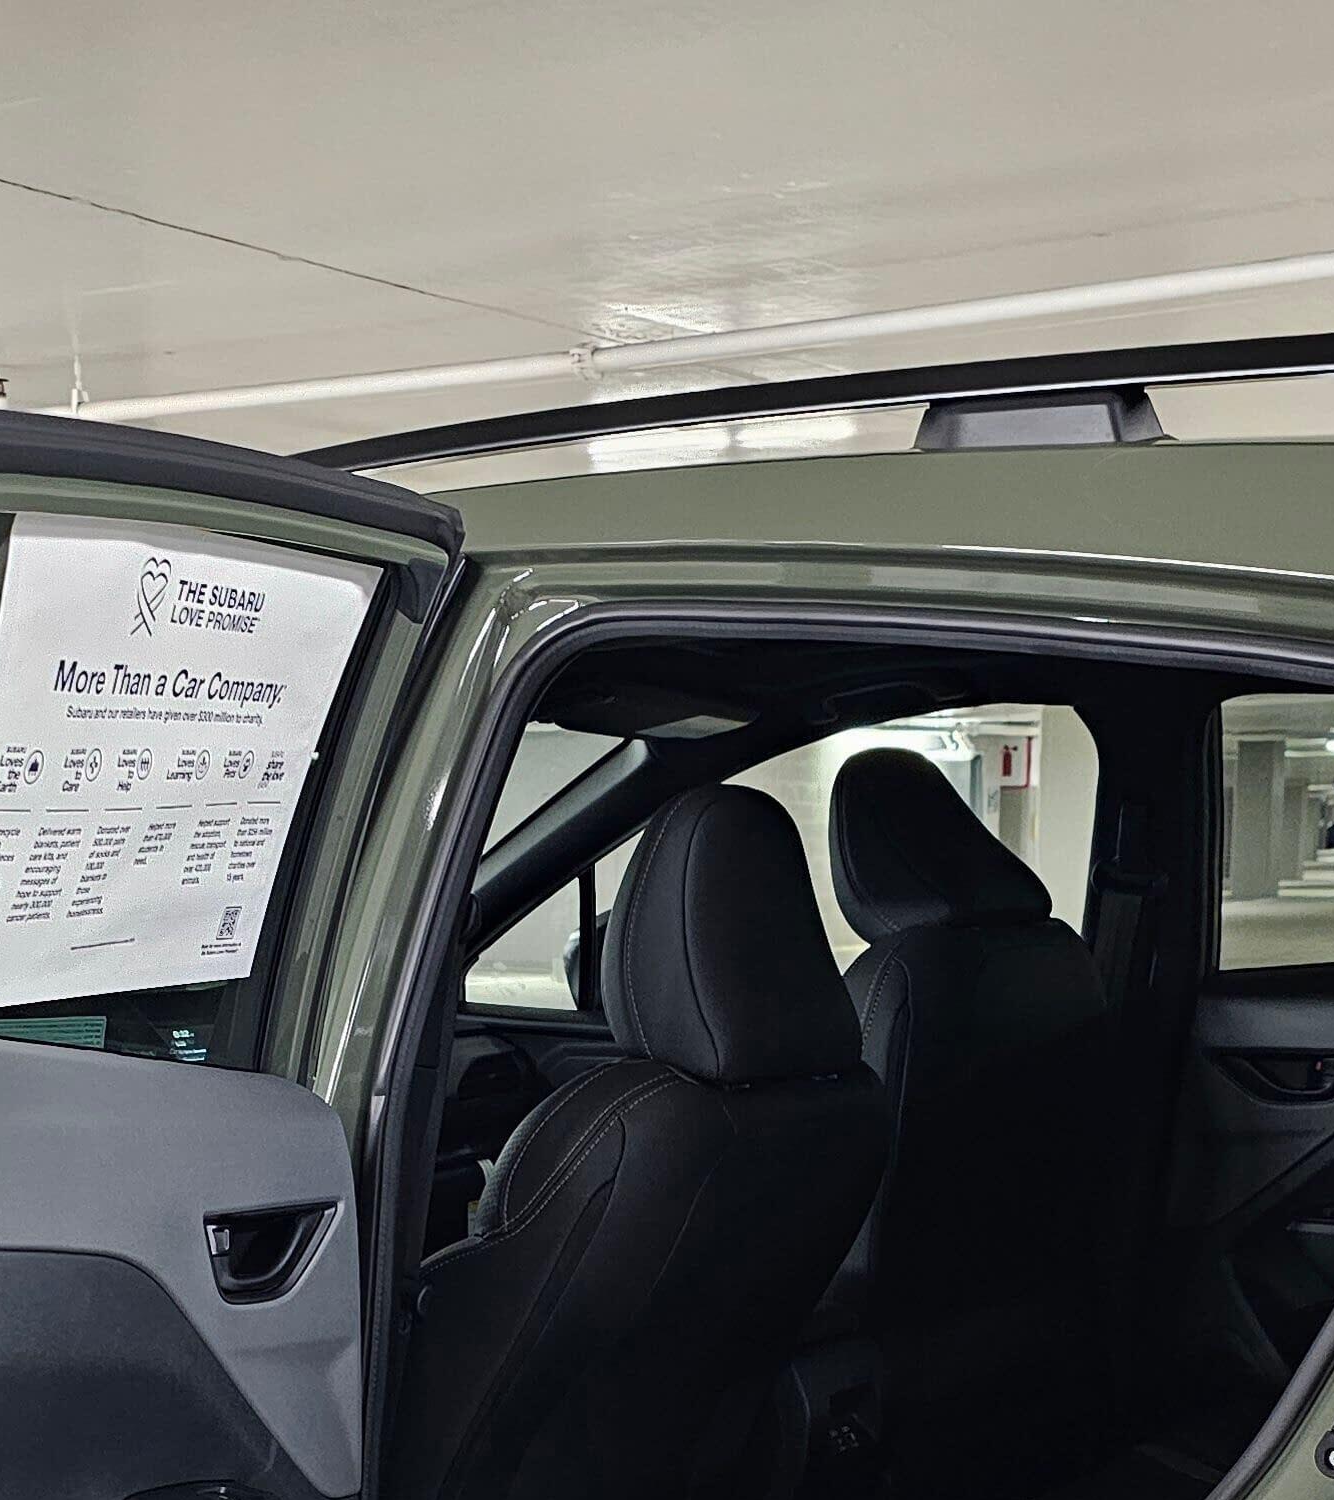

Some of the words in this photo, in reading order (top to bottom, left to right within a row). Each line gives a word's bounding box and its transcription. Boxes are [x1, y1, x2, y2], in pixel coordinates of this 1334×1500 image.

[178, 580, 207, 604] THE
[209, 585, 265, 612] SUBARU
[170, 605, 204, 628] LOVE
[54, 660, 106, 695] More
[111, 664, 151, 696] Than
[155, 674, 167, 697] a
[172, 669, 204, 699] Car
[67, 706, 93, 719] Subaru
[94, 707, 106, 719] and
[107, 710, 118, 719] our
[119, 708, 146, 720] retailers
[147, 709, 163, 720] have
[164, 710, 182, 724] given
[182, 712, 197, 722] over
[214, 711, 235, 723] million
[235, 713, 242, 724] to
[0, 756, 24, 766] Loves
[63, 756, 84, 768] Loves
[118, 756, 136, 767] Loves
[178, 757, 195, 767] Loves
[8, 770, 20, 780] the
[62, 781, 79, 792] Care
[117, 781, 131, 793] Help
[0, 828, 20, 838] recycle
[38, 827, 66, 836] Delivered
